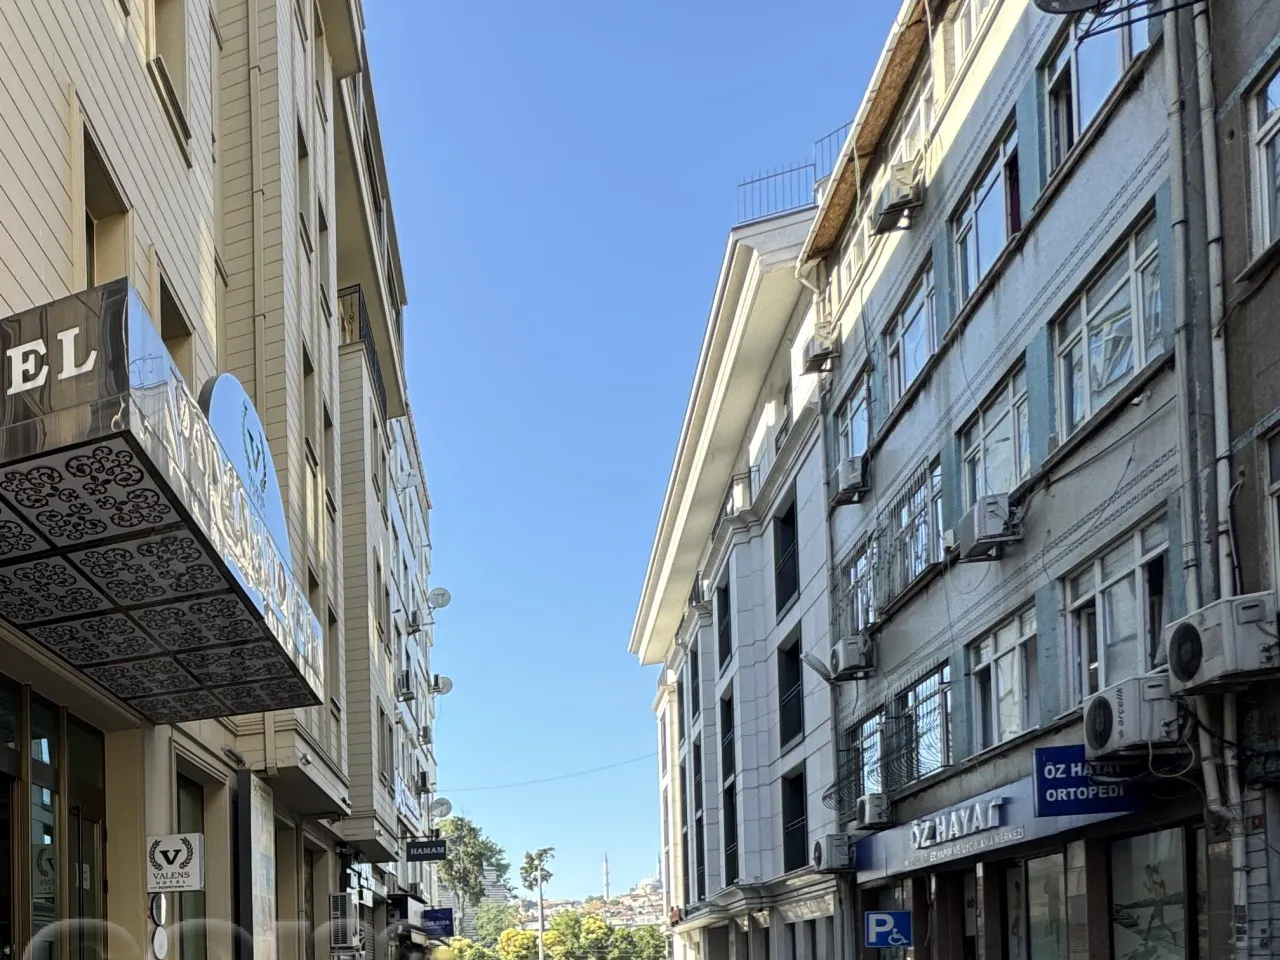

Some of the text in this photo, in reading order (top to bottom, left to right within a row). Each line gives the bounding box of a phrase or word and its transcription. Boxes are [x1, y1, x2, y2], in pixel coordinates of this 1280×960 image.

[1044, 762, 1066, 779] ÖZ
[909, 797, 1004, 850] ÖZ HAYAT
[159, 849, 182, 865] V
[410, 846, 445, 856] HAMAM
[153, 871, 191, 880] VALENS
[868, 913, 895, 943] P
